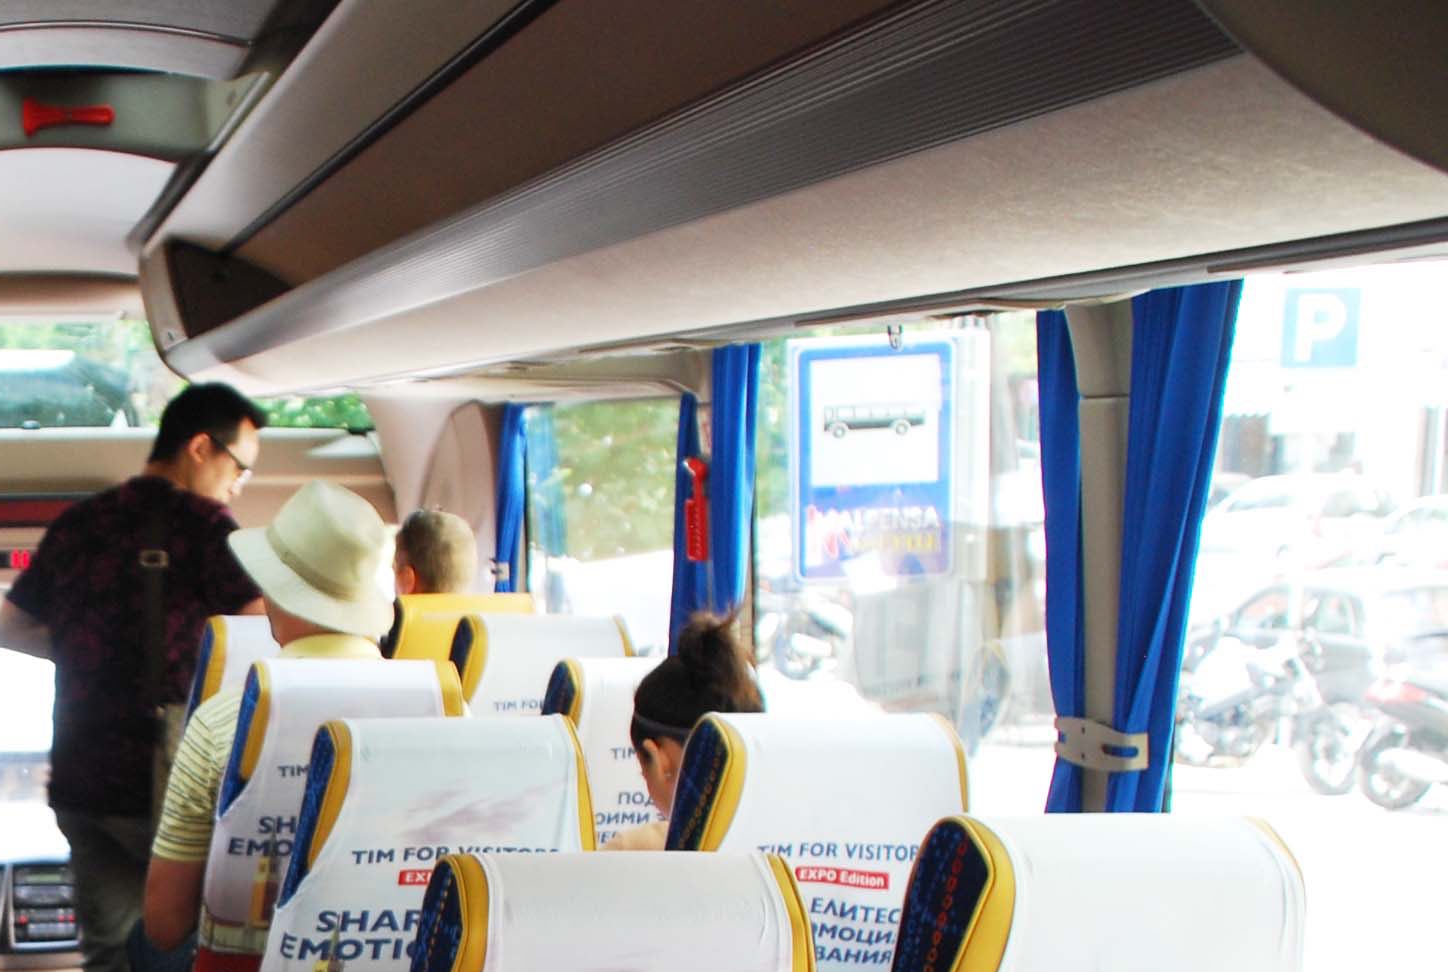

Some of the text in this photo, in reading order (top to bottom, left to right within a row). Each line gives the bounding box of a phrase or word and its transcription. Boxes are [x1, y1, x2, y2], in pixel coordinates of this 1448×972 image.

[1295, 293, 1344, 361] P
[277, 764, 310, 777] TIM
[352, 848, 395, 864] TIM
[799, 842, 838, 857] FOR
[799, 868, 885, 887] EXPO Edition
[316, 909, 422, 933] SHAR
[810, 897, 901, 925] ЕЛИТЕС
[811, 922, 897, 947] МОЦИ
